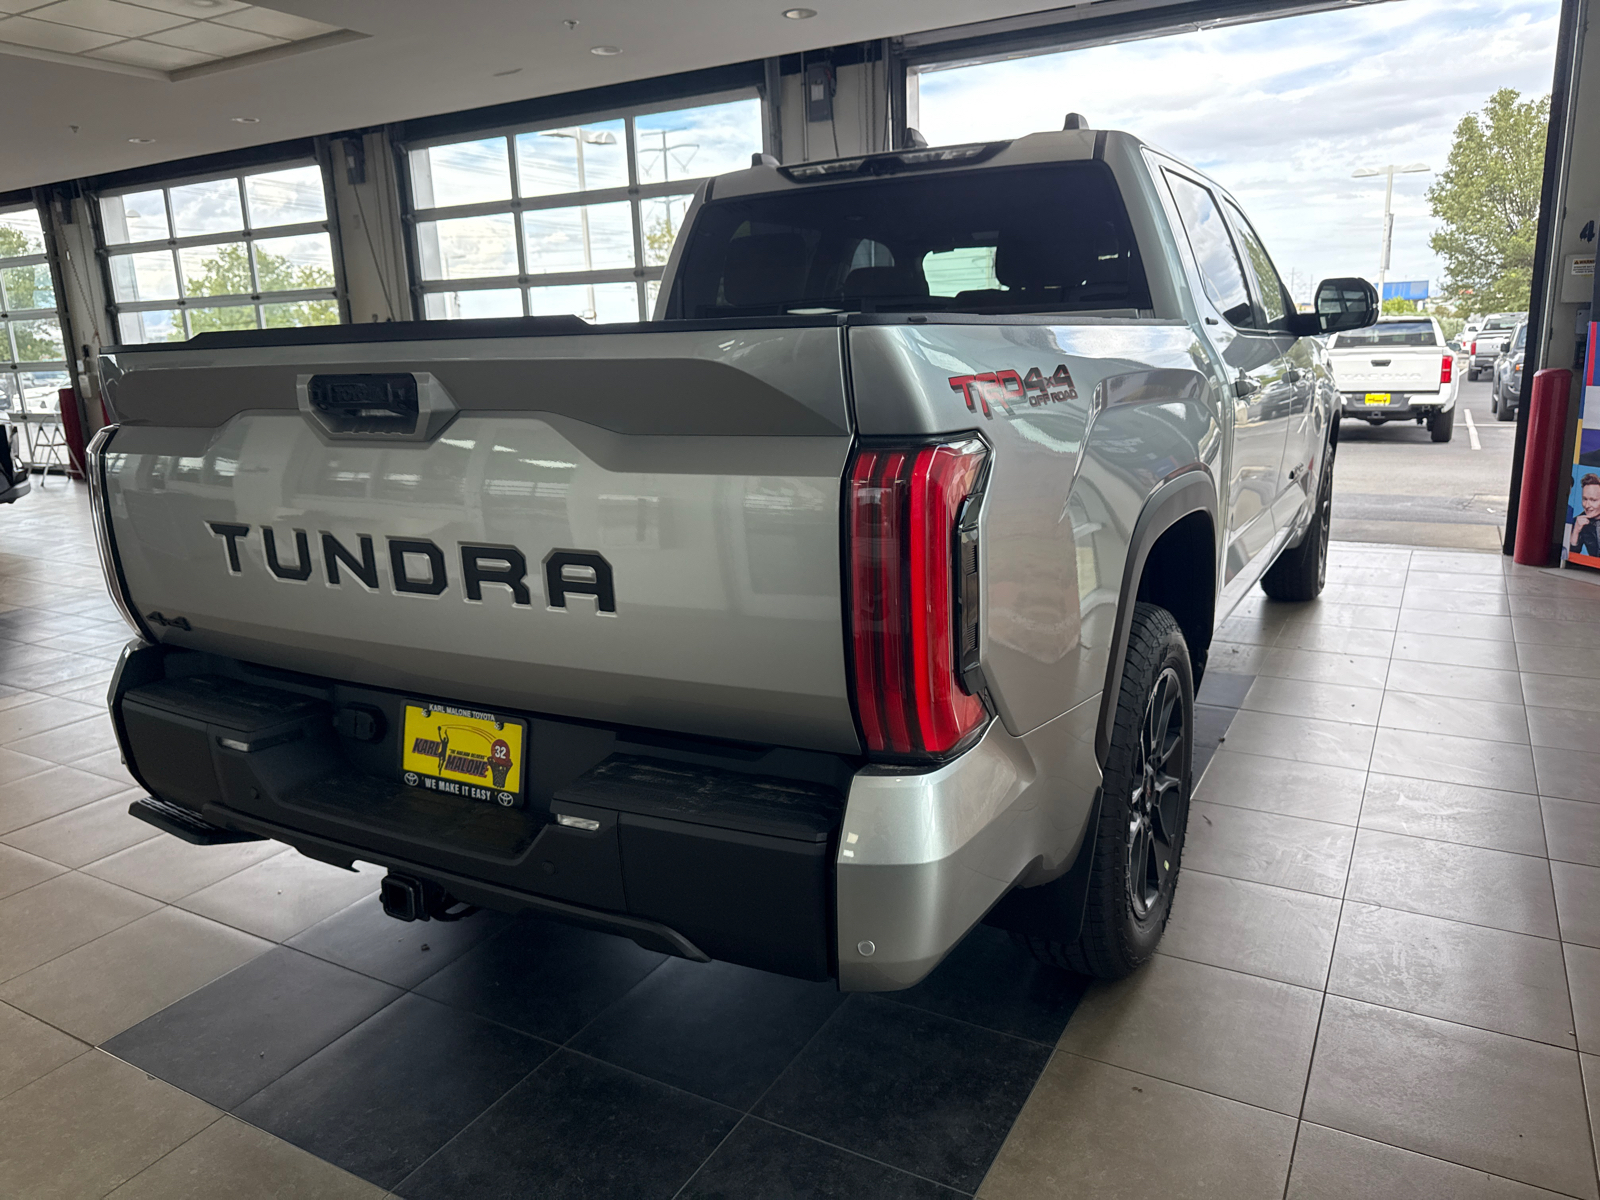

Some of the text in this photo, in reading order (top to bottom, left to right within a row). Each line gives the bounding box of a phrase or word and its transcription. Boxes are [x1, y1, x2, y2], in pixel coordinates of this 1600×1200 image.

[1579, 219, 1596, 243] 4
[948, 364, 1076, 420] TRD 4x4
[1029, 388, 1079, 407] OFF ROAD
[203, 519, 618, 618] TUNDRA
[429, 703, 496, 722] KARL MALONE TOYOTA
[411, 737, 442, 758] KARL
[494, 745, 507, 759] 32
[444, 754, 489, 778] MALONE
[424, 777, 491, 801] WE MAKE IT EASY
